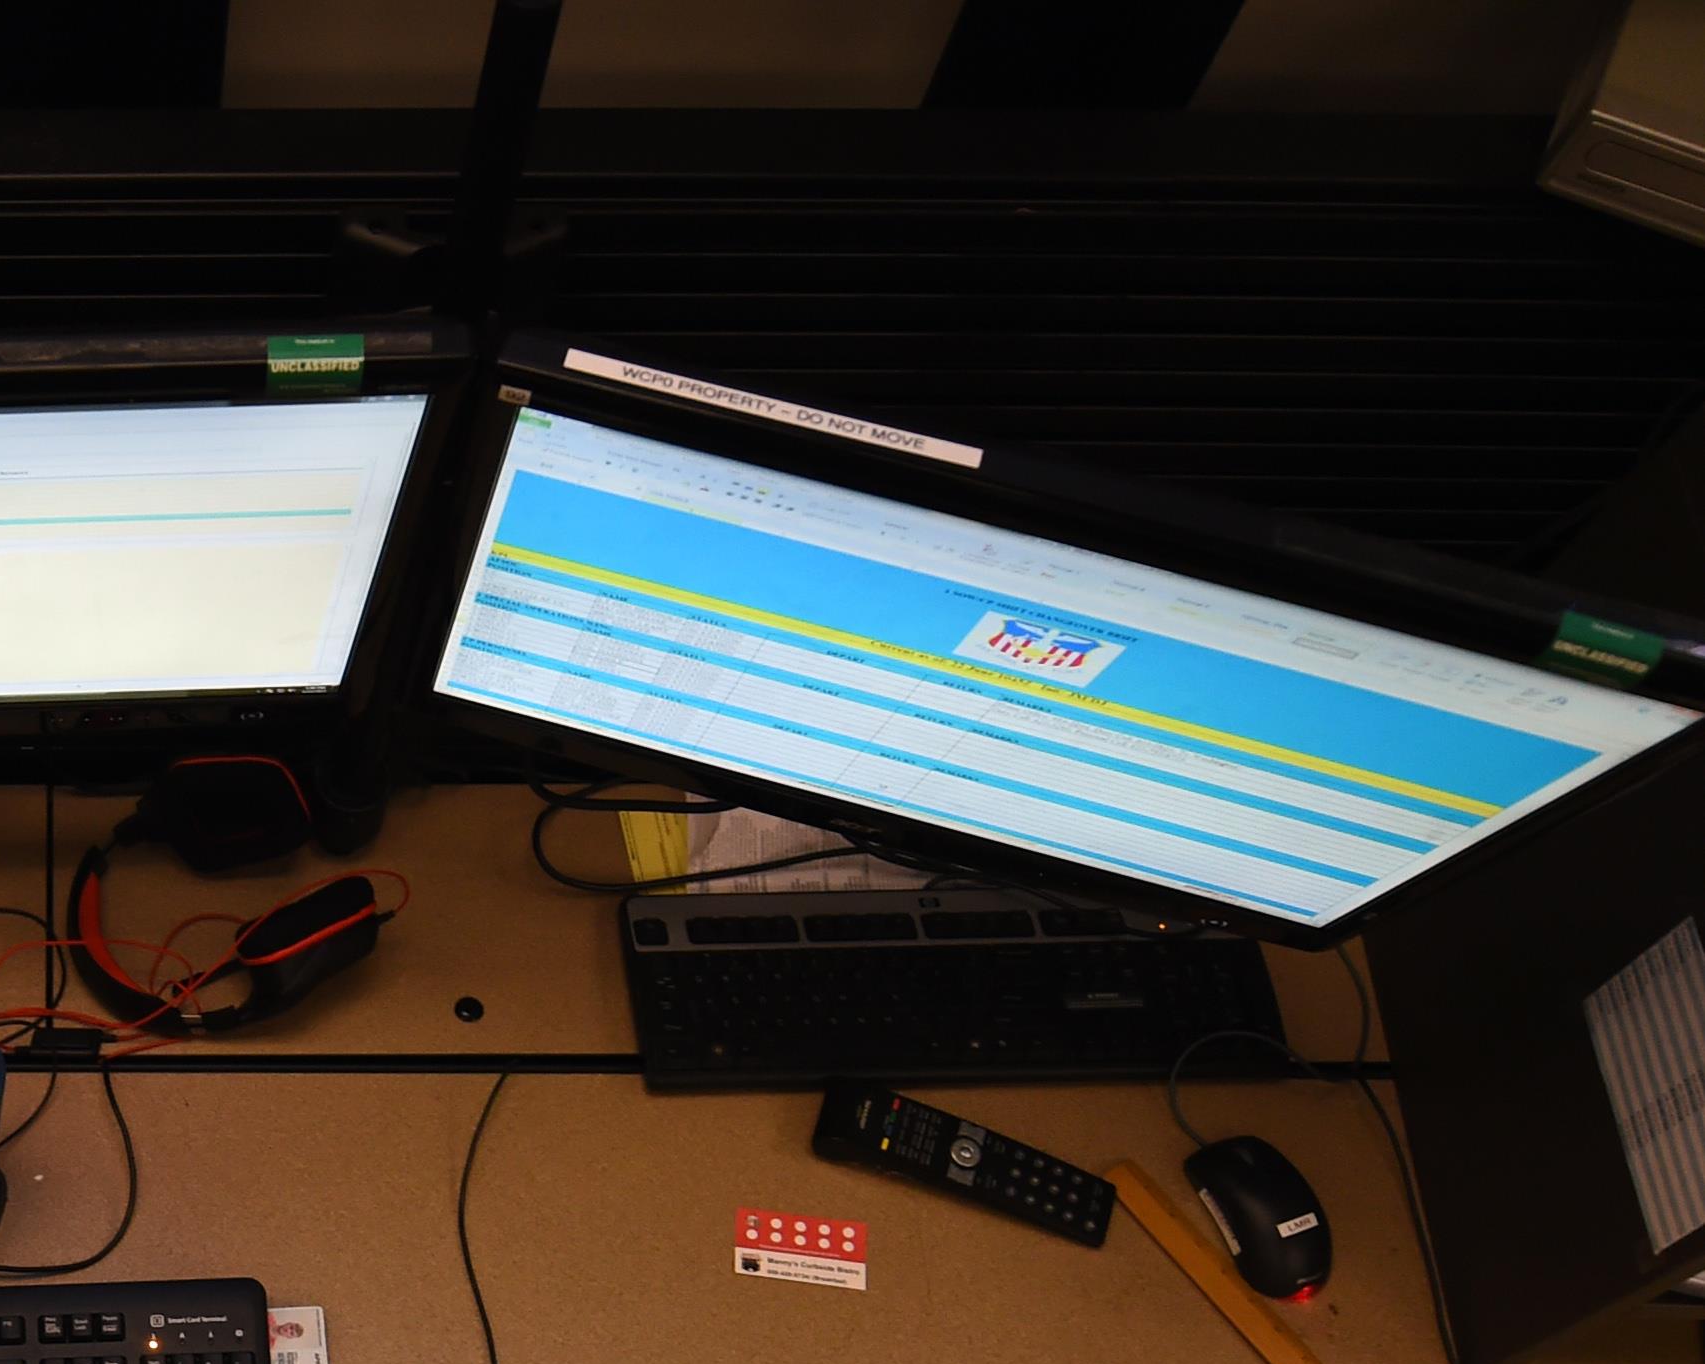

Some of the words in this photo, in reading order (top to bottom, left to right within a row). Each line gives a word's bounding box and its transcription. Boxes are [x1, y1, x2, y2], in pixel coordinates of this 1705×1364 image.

[271, 360, 359, 373] UNCLASSIFIED
[677, 376, 777, 414] PROPERTY
[795, 408, 825, 425] DO
[827, 417, 865, 436] NOT
[869, 427, 926, 451] MOVE
